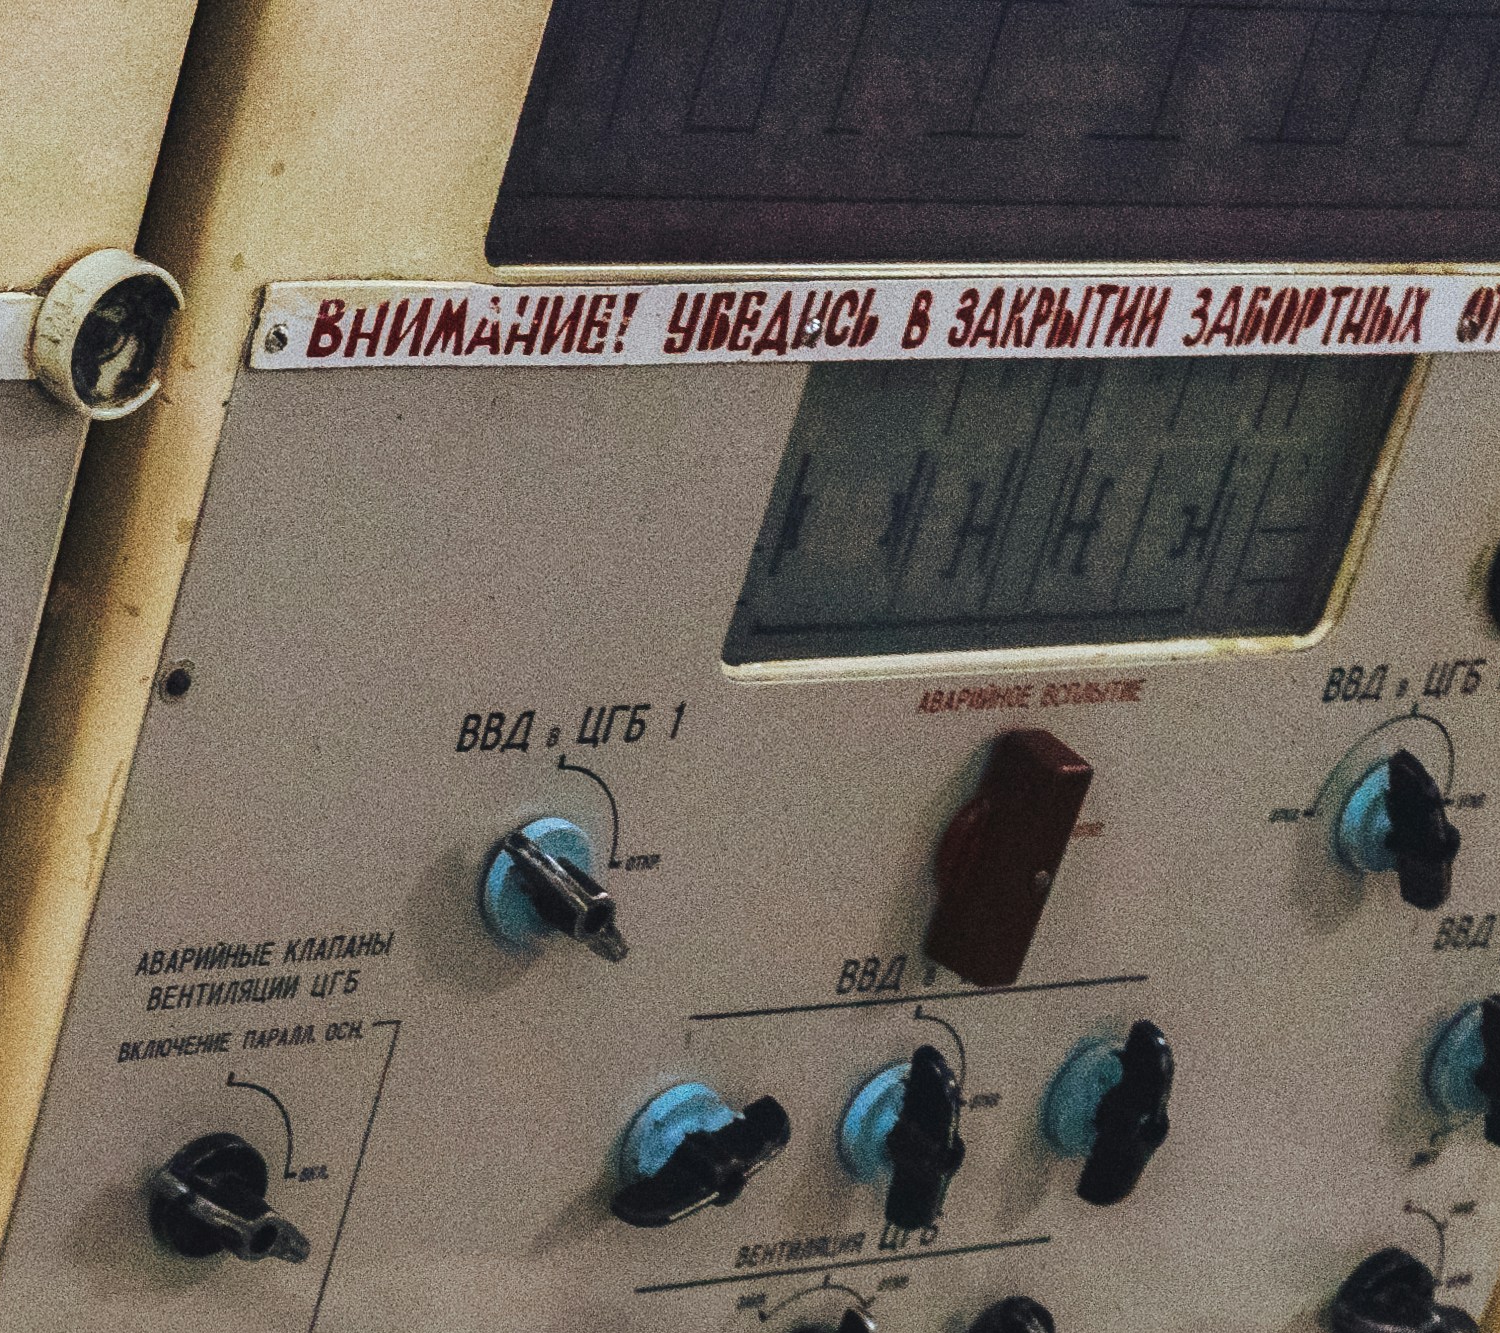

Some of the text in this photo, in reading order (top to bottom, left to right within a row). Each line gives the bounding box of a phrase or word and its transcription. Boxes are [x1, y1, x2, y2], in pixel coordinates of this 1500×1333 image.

[306, 290, 643, 358] ВНИМАНИЕ!
[662, 288, 880, 356] УБЕДИСЬ
[902, 290, 932, 349] В
[948, 284, 1172, 350] ЗАКРЫТИИ
[1182, 285, 1432, 349] ЗАБОРТНЫХ
[1323, 666, 1389, 702] ВВД
[1423, 659, 1487, 699] ЦГБ
[455, 703, 687, 752] ВВД ЦГБ 1
[135, 931, 395, 977] АВАРИЙНЫЕ КЛАПАНЫ
[835, 955, 907, 995] ВВД
[310, 970, 361, 998] ЦГБ
